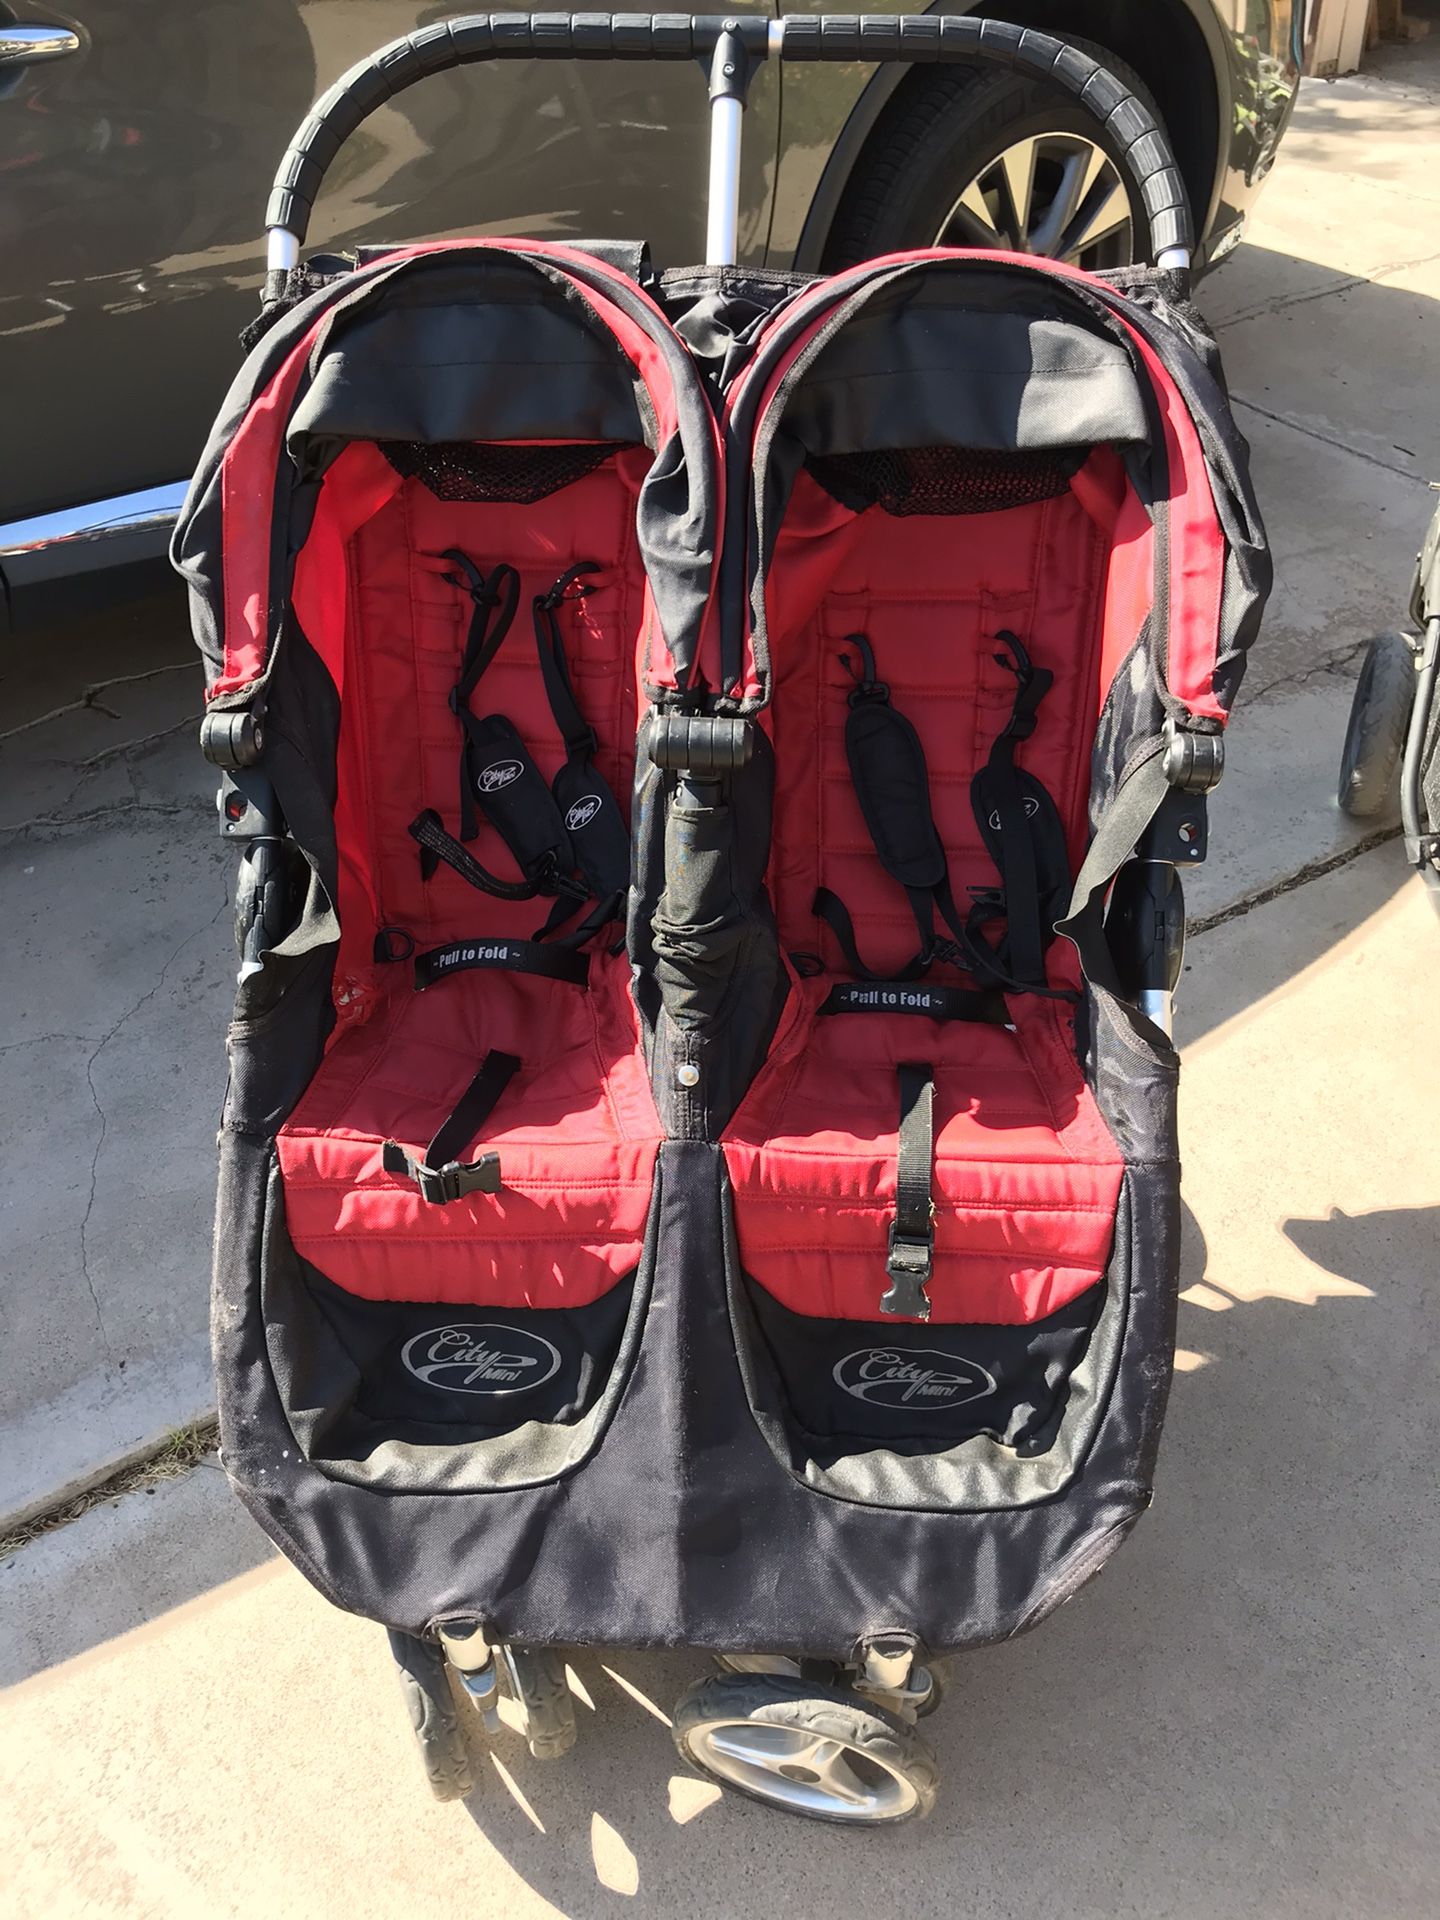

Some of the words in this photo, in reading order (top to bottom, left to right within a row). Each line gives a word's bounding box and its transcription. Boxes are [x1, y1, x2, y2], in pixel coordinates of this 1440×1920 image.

[439, 950, 460, 968] Pull
[461, 949, 476, 960] to
[478, 946, 508, 960] Fold
[881, 992, 898, 1004] to
[900, 992, 930, 1007] Fold
[427, 1329, 504, 1384] City
[858, 1350, 937, 1402] City
